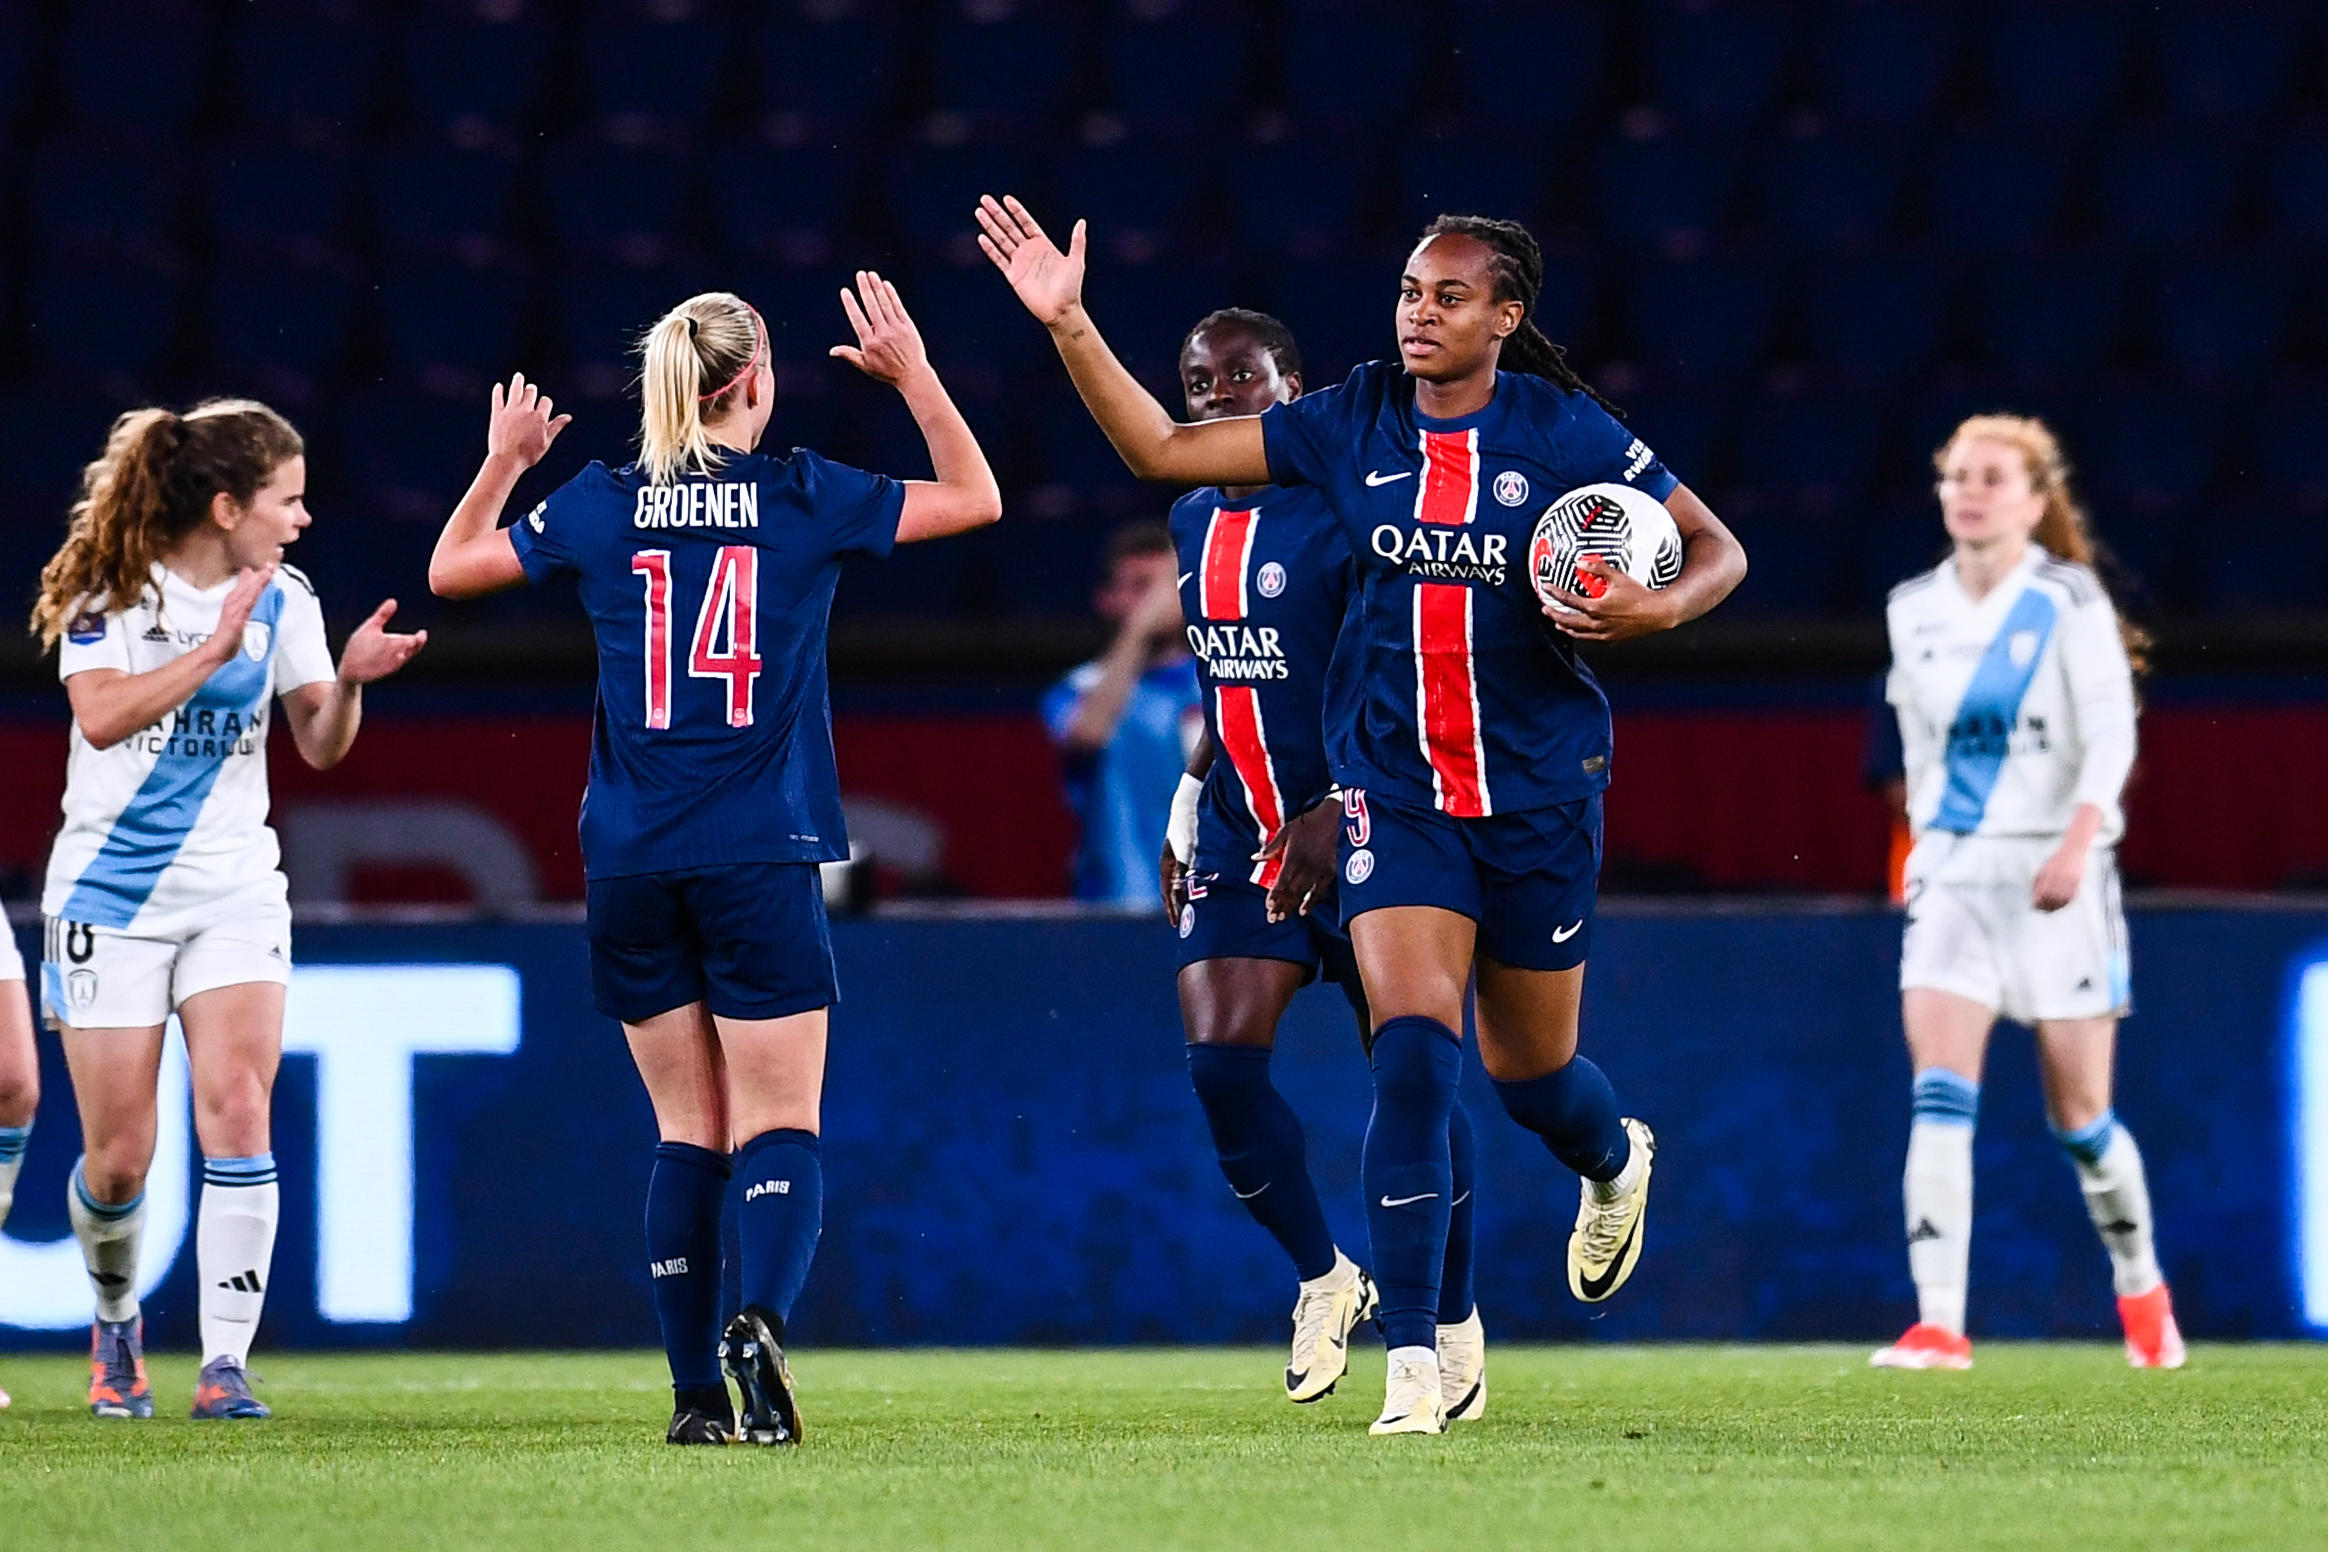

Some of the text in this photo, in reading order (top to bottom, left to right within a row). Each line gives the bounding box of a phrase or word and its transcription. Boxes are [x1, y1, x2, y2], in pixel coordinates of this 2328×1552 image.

[633, 482, 759, 528] GROENEN
[1371, 524, 1507, 566] QATAR
[1408, 561, 1506, 586] AIRWAYS
[631, 545, 763, 730] 14
[1186, 624, 1285, 662] QATAR
[1209, 658, 1289, 679] AIRWAYS
[746, 1180, 790, 1202] PARIS
